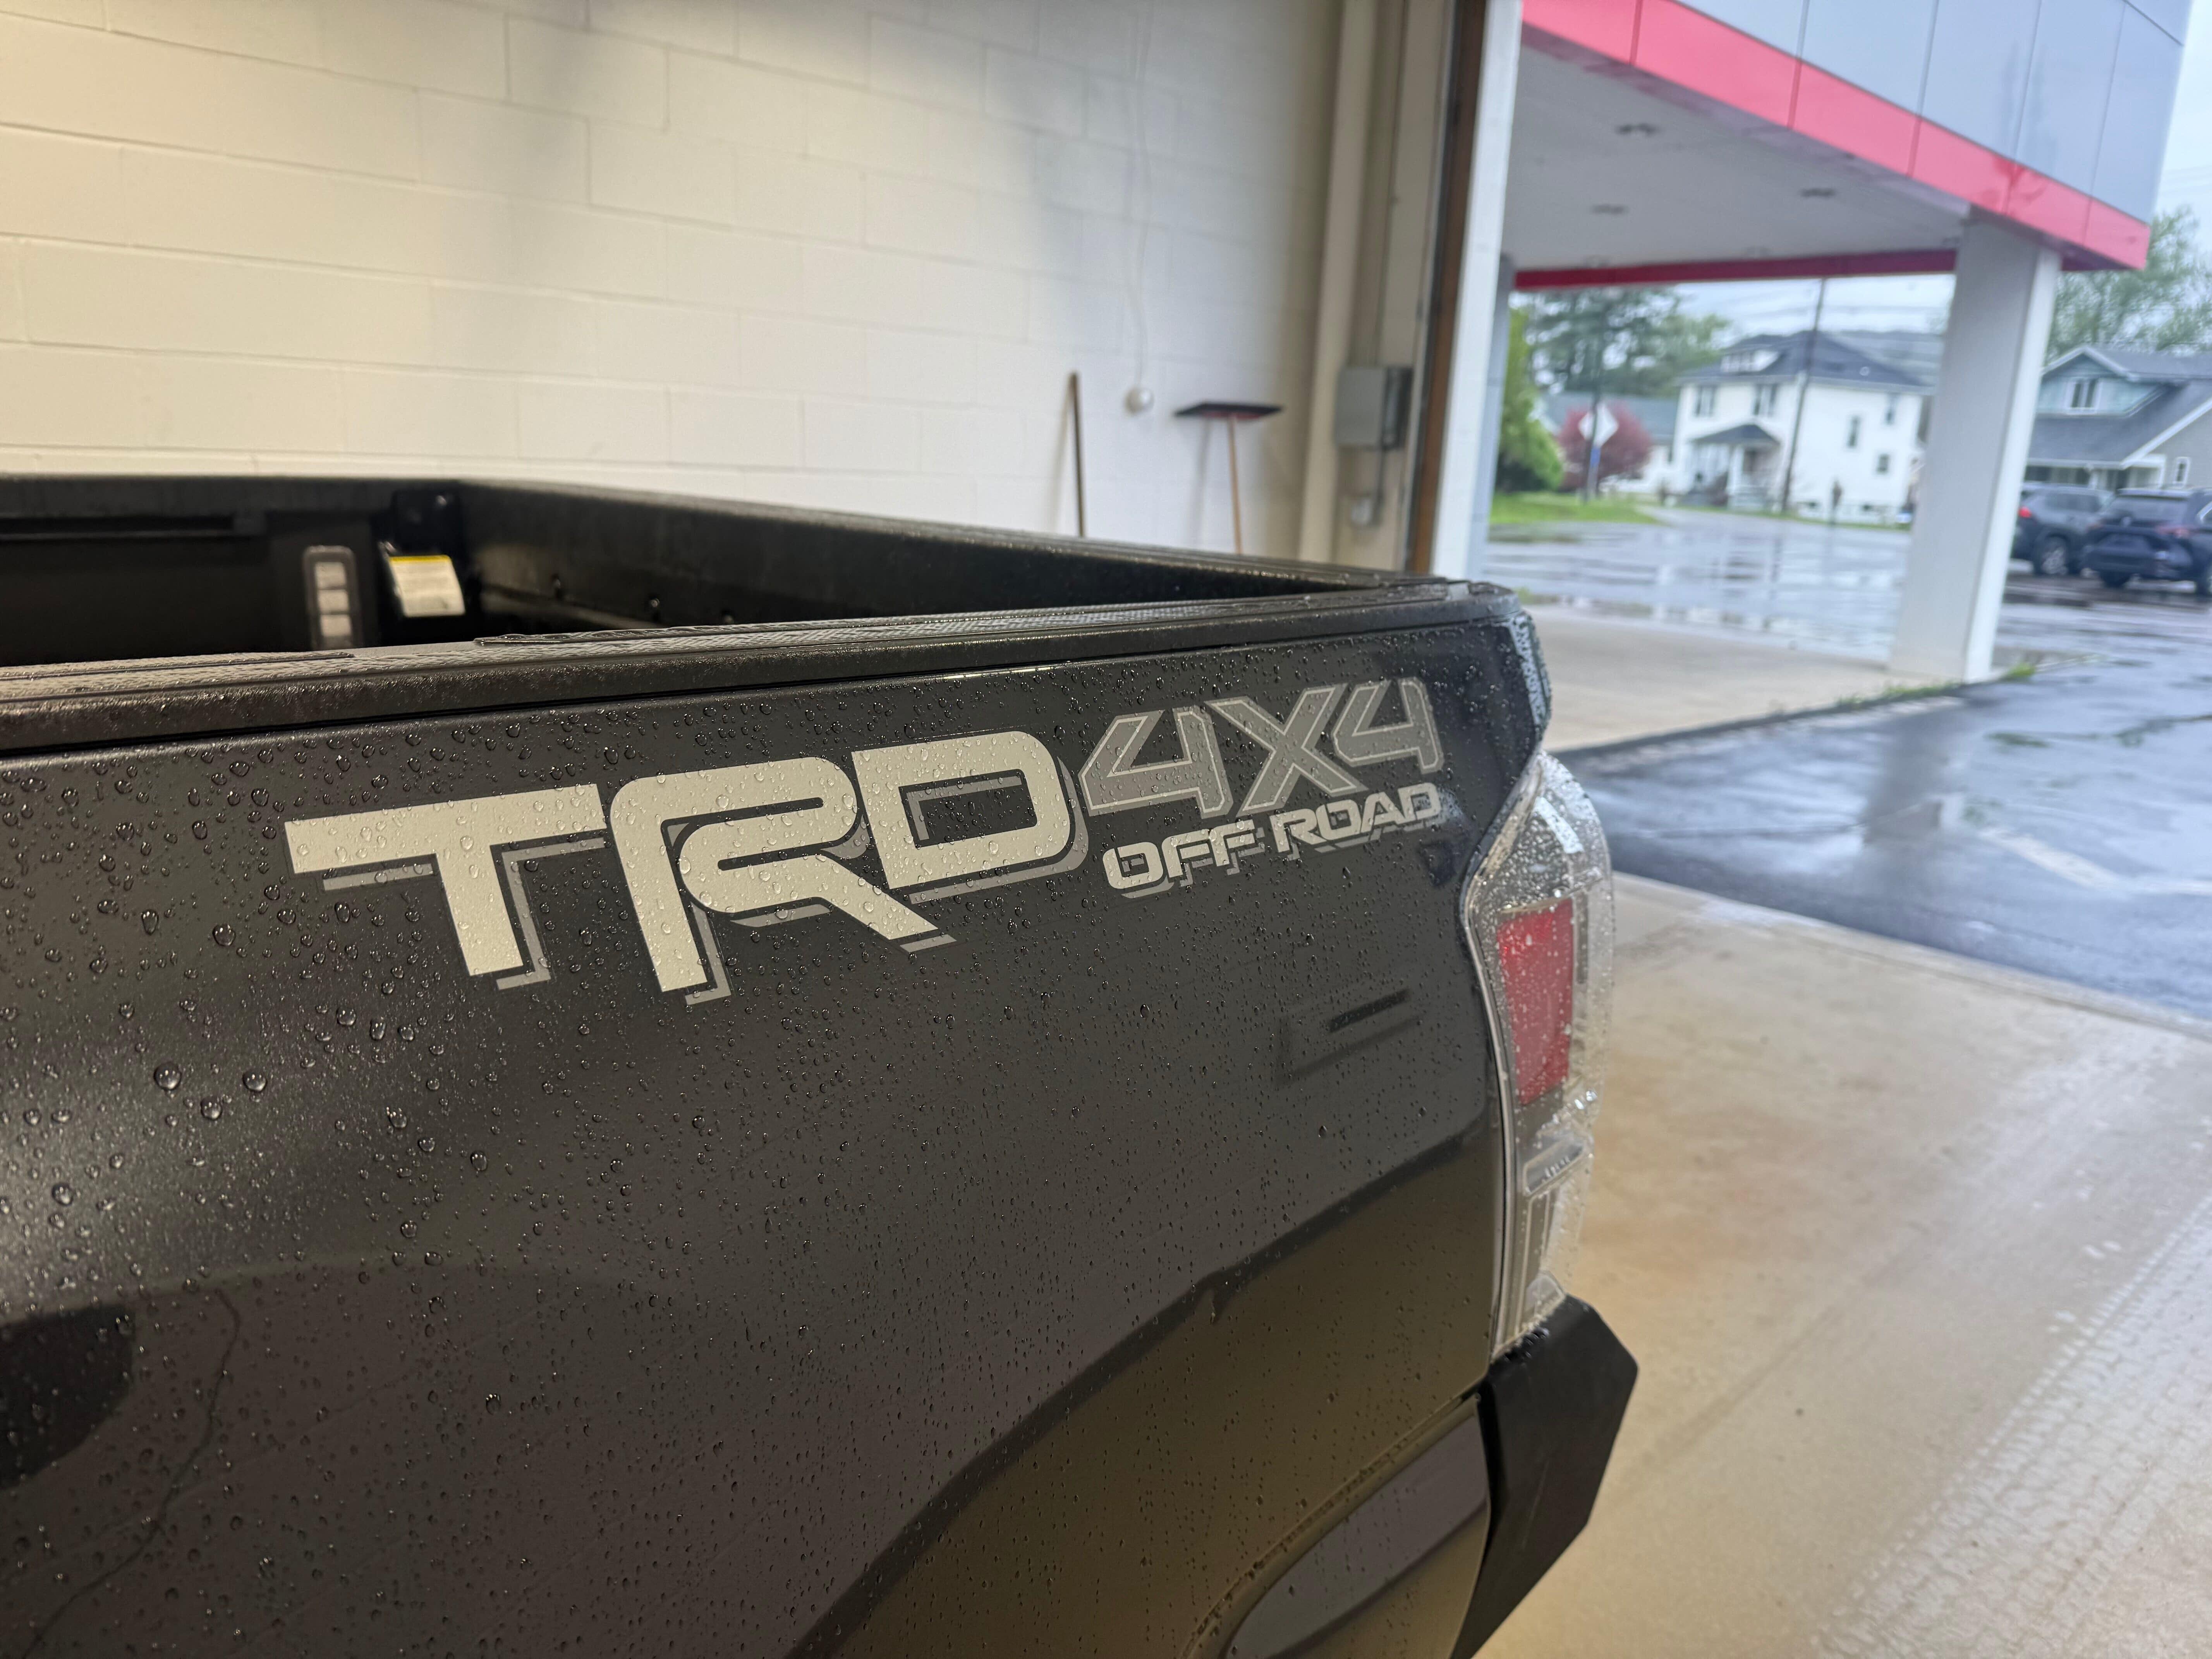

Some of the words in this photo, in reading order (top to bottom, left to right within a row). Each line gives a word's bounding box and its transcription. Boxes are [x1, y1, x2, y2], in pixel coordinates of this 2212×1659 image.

[1079, 676, 1445, 819] 4X4
[284, 730, 1086, 1005] TRD
[1102, 819, 1264, 897] OFF
[1269, 782, 1444, 858] ROAD
